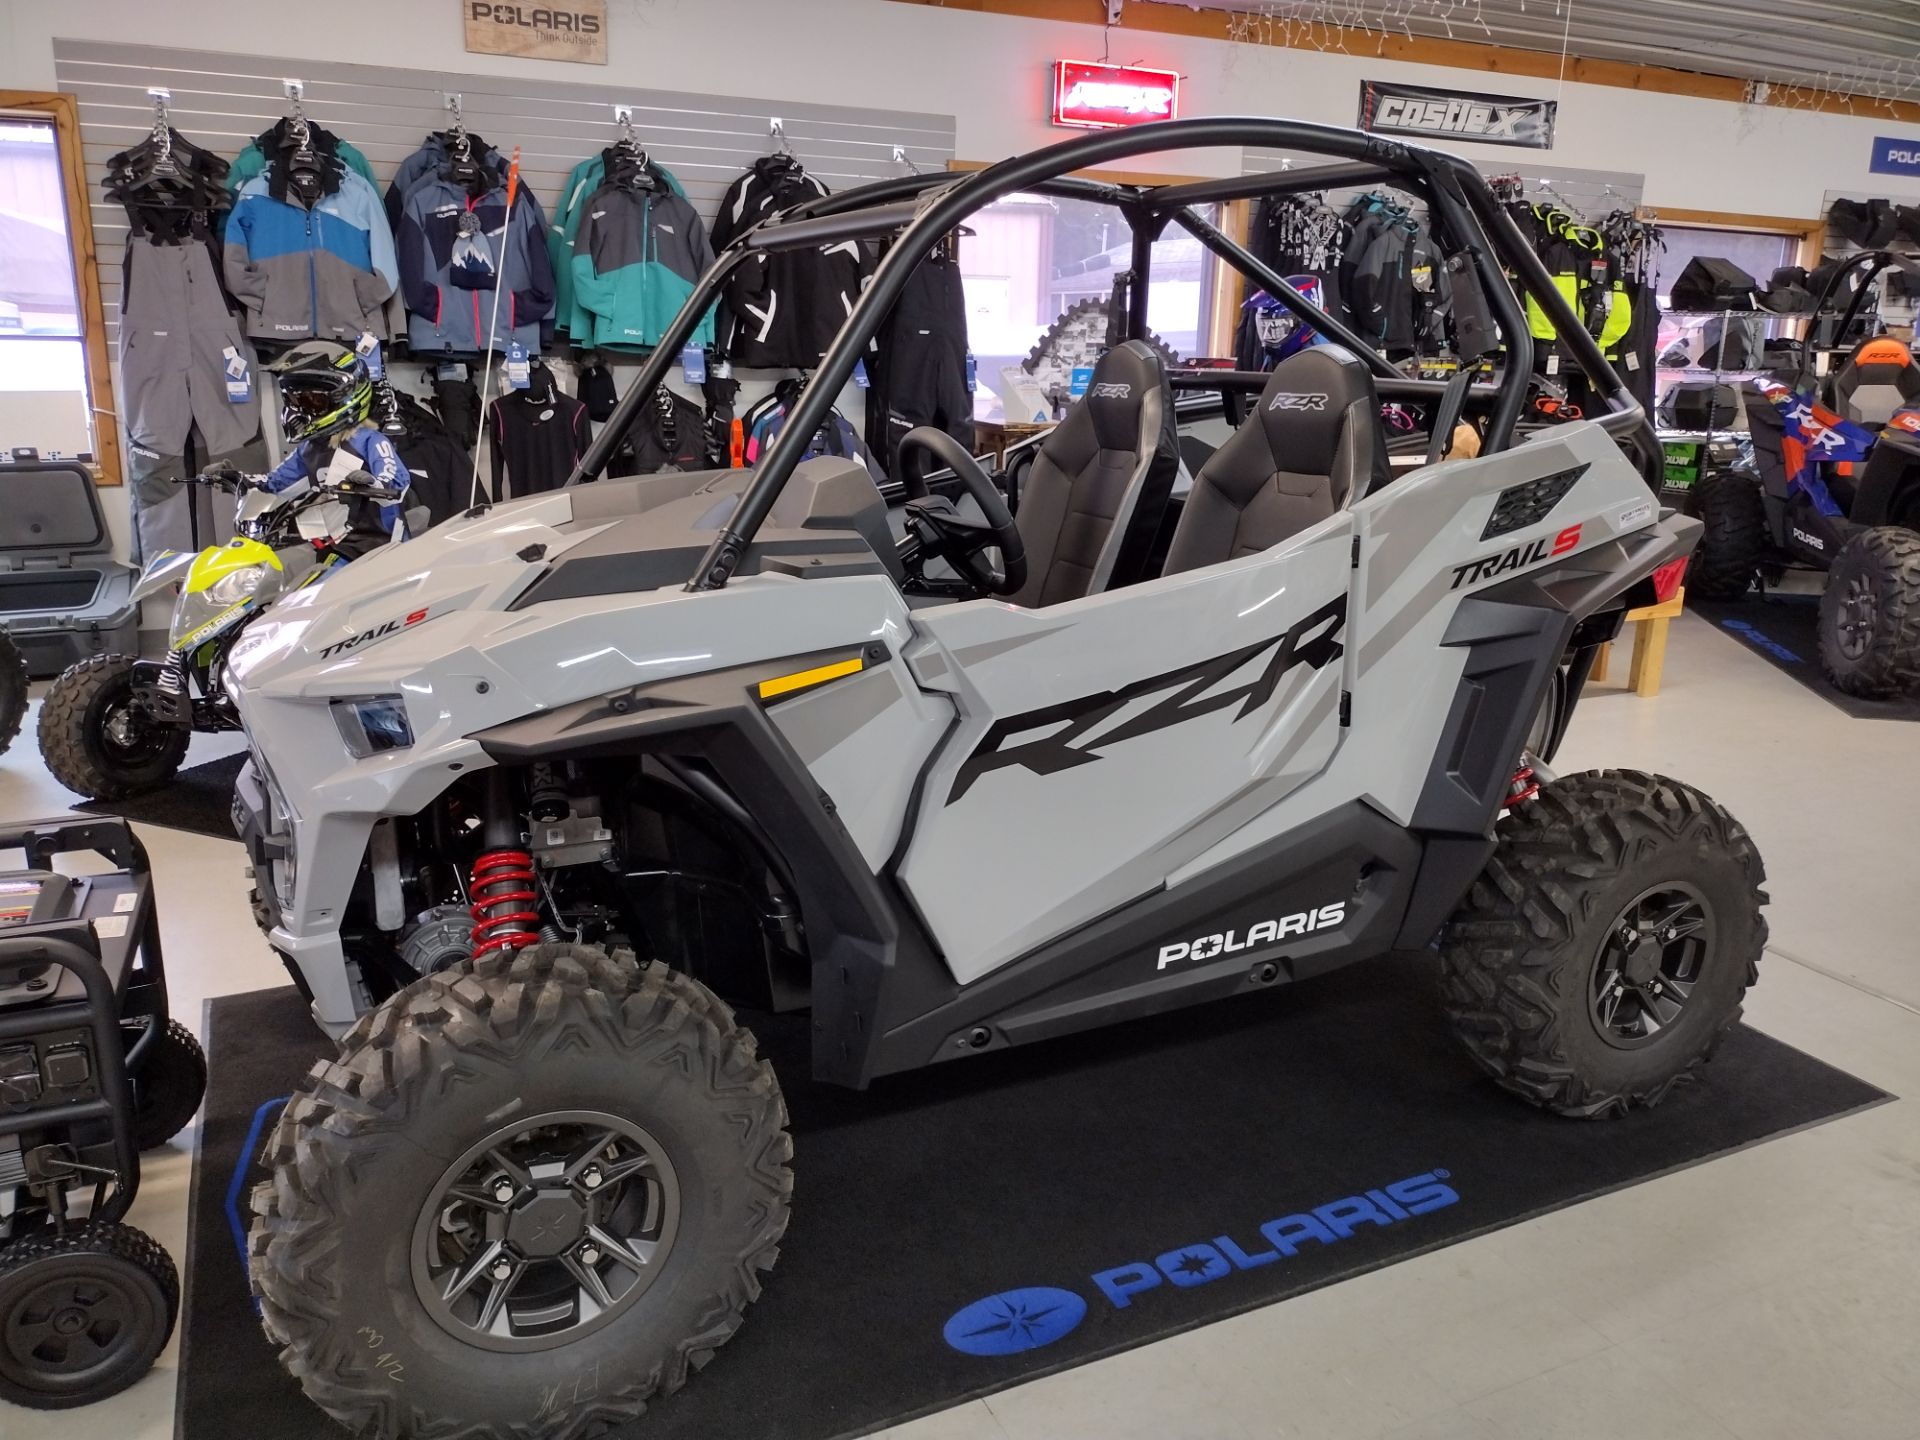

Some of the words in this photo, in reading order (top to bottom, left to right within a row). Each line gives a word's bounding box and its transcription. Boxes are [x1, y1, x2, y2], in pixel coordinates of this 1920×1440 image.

[472, 2, 600, 33] POLARIS
[535, 30, 560, 42] Think
[562, 34, 598, 46] Outside
[1091, 382, 1132, 399] RZR
[1269, 392, 1329, 411] RZR
[1792, 527, 1824, 550] POLARIS
[1450, 538, 1548, 590] TRAIL
[191, 606, 245, 643] POLARIS
[319, 620, 400, 660] TRAIL
[944, 592, 1347, 807] RZR
[1157, 901, 1346, 970] POLARIS
[1090, 1171, 1460, 1309] POLARIS
